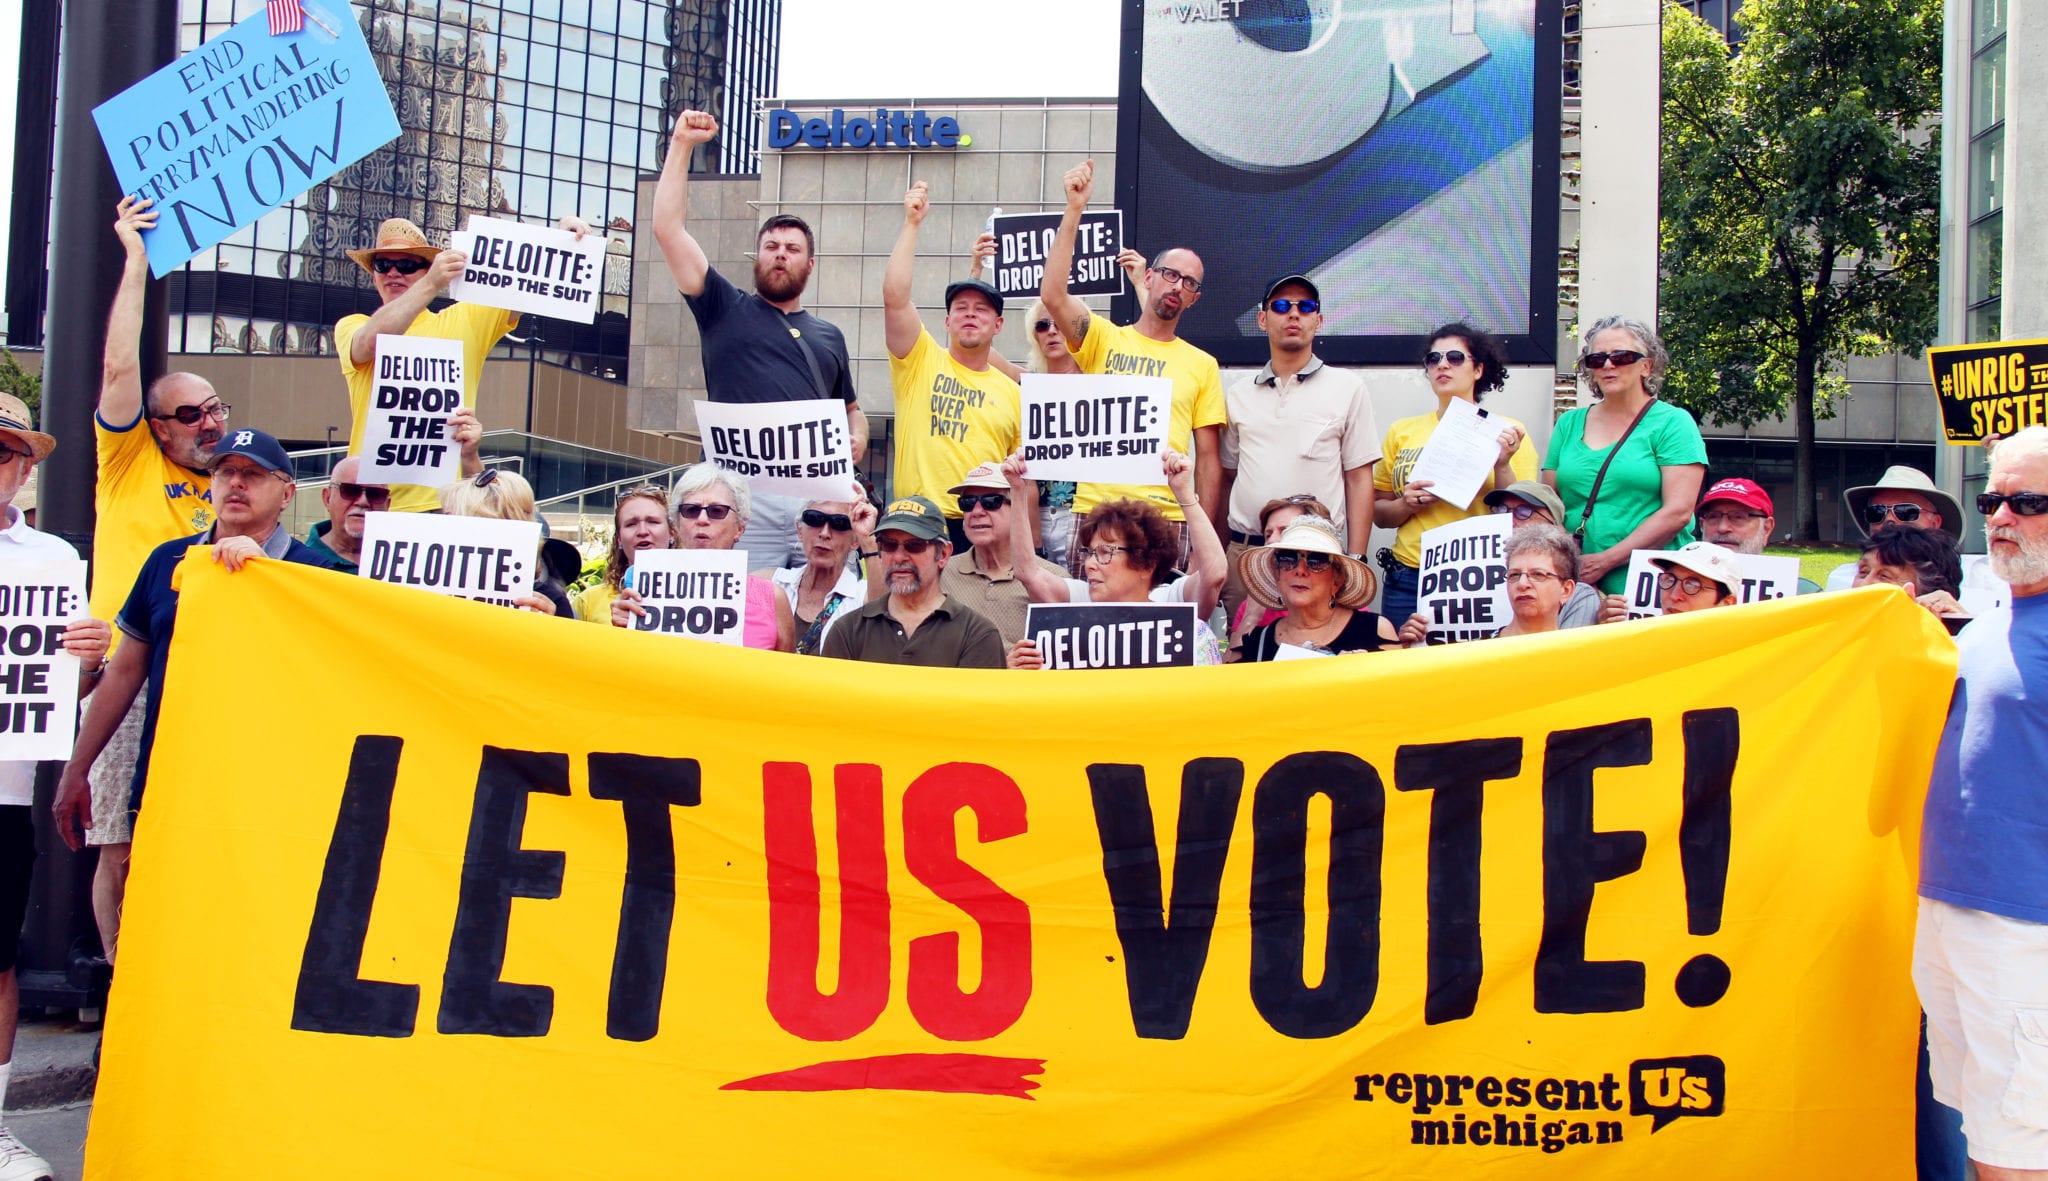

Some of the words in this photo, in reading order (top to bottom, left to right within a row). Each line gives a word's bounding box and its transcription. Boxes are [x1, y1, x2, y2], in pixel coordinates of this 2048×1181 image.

[1175, 0, 1244, 22] VALET
[177, 40, 244, 94] END
[128, 42, 320, 172] POLITICAL
[129, 58, 351, 203] ERRYMANDERING
[170, 96, 344, 253] NOW
[471, 235, 593, 284] DELOITTE:
[1001, 222, 1113, 264] DELOTE:
[464, 269, 513, 288] DROP
[517, 277, 549, 296] THE
[552, 285, 592, 303] SUIT
[999, 264, 1044, 293] DROP
[1077, 255, 1116, 283] SUIT
[380, 355, 460, 383] DELOITTE:
[1105, 348, 1167, 377] COUNTRY
[1941, 352, 2025, 401] #UNRIG
[376, 385, 460, 413] DROP
[930, 394, 965, 420] OVER
[1028, 395, 1158, 440] DELOITTE:
[388, 415, 448, 440] THE
[710, 418, 842, 461] DELOITTE:
[375, 443, 448, 468] SUIT
[712, 457, 761, 477] DROP
[765, 464, 803, 478] THE
[806, 458, 847, 478] SUIT
[1024, 443, 1074, 461] DROP
[1078, 441, 1112, 458] THE
[1117, 438, 1160, 456] SUIT
[370, 539, 522, 592] DELOITTE:
[1421, 565, 1507, 598] DROP
[637, 571, 741, 600] DELOITTE:
[635, 605, 738, 635] DROP
[1429, 597, 1494, 625] THE
[1036, 619, 1183, 670] DELOITTE:
[290, 734, 701, 1042] LET
[762, 760, 1033, 1042] US
[1085, 706, 1739, 1040] VOTE!
[1353, 1071, 1623, 1114] represent
[1410, 1114, 1624, 1153] michigan
